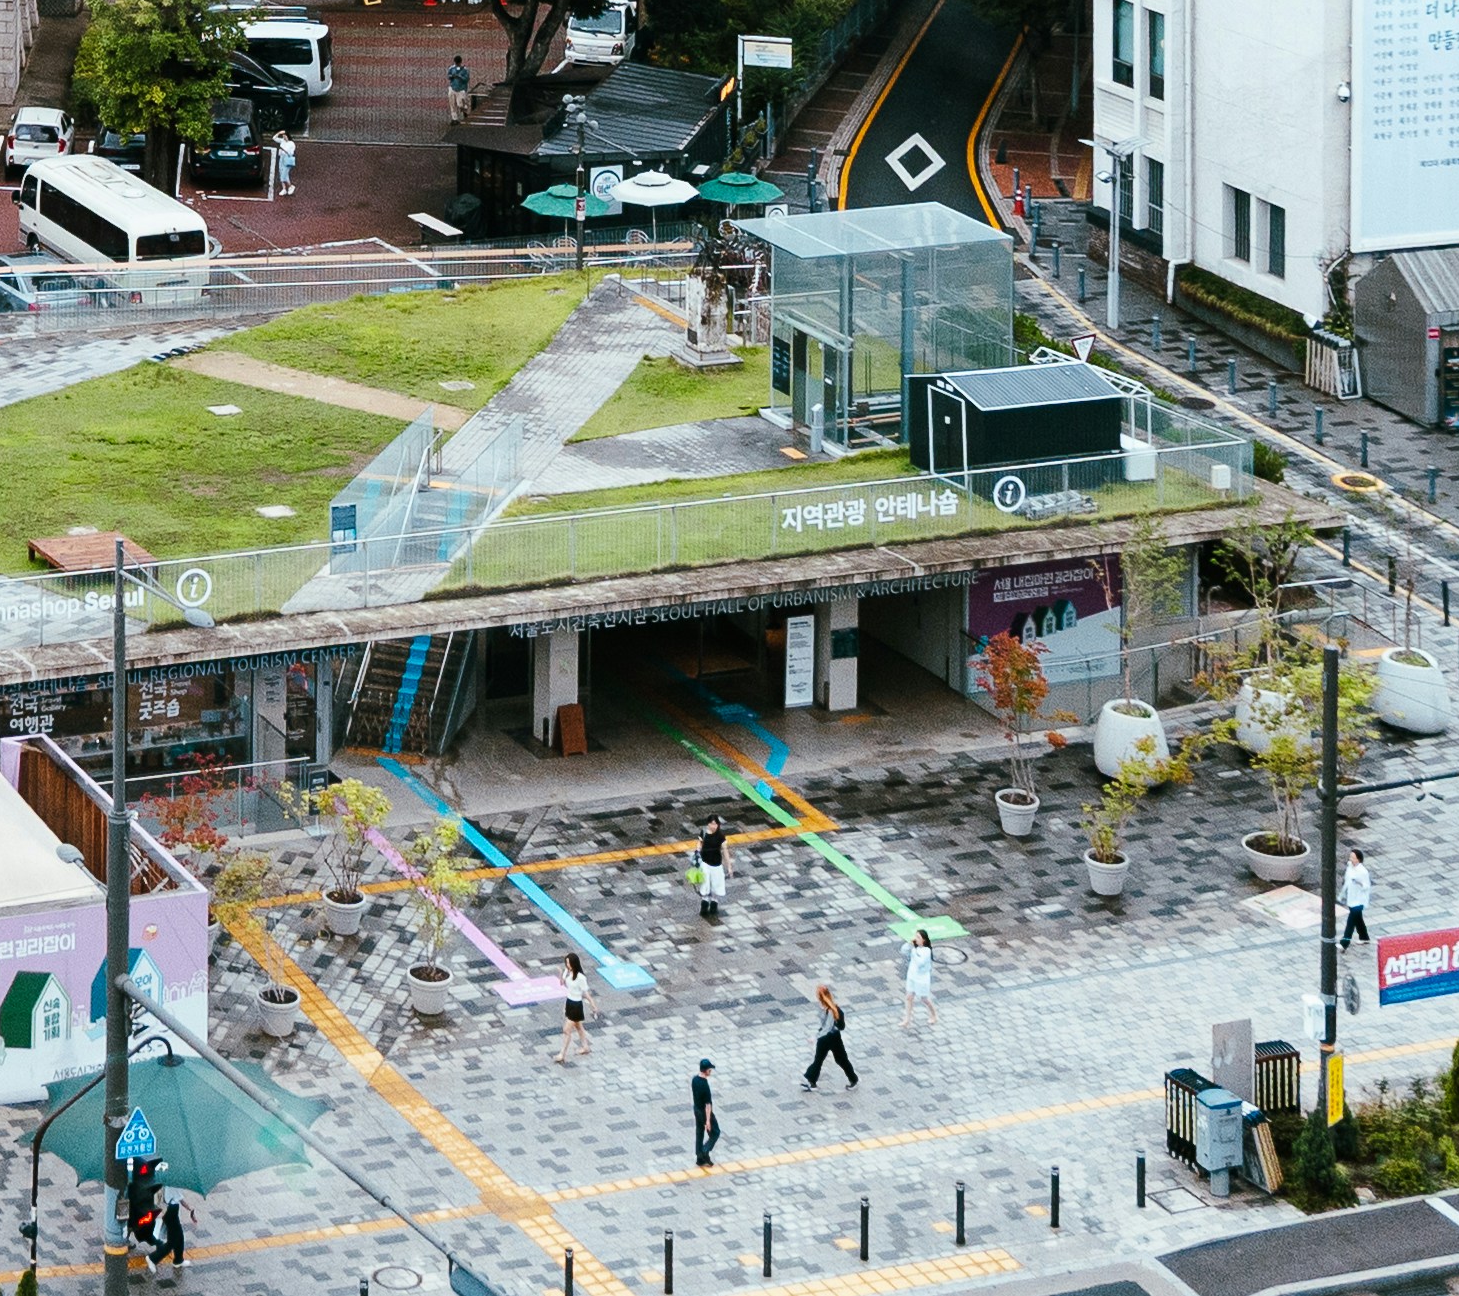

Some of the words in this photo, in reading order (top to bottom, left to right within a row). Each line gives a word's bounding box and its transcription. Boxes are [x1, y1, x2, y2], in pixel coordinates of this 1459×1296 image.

[1426, 0, 1438, 19] 더
[781, 497, 867, 532] 지역관광
[874, 489, 959, 523] 안테나숍
[994, 577, 1011, 590] 서울
[510, 610, 647, 639] 서울도시건축전시관
[651, 606, 698, 624] SEOUL
[704, 598, 744, 616] HALL
[748, 595, 765, 612] OF
[772, 585, 853, 609] URBANISM
[855, 587, 866, 600] &
[870, 571, 979, 597] ARCHITECTURE
[97, 669, 144, 689] SEUL
[149, 661, 224, 683] REGIONAL
[229, 652, 297, 673] TOURISM
[300, 645, 356, 665] CENTER
[139, 681, 167, 700] 전국
[9, 692, 38, 716] 전국
[138, 698, 180, 721] 굿즈숍
[9, 713, 55, 734] 여행관
[1383, 944, 1450, 986] 선관위
[44, 998, 60, 1013] 신속
[44, 1012, 60, 1026] 통합
[44, 1025, 60, 1042] 기획
